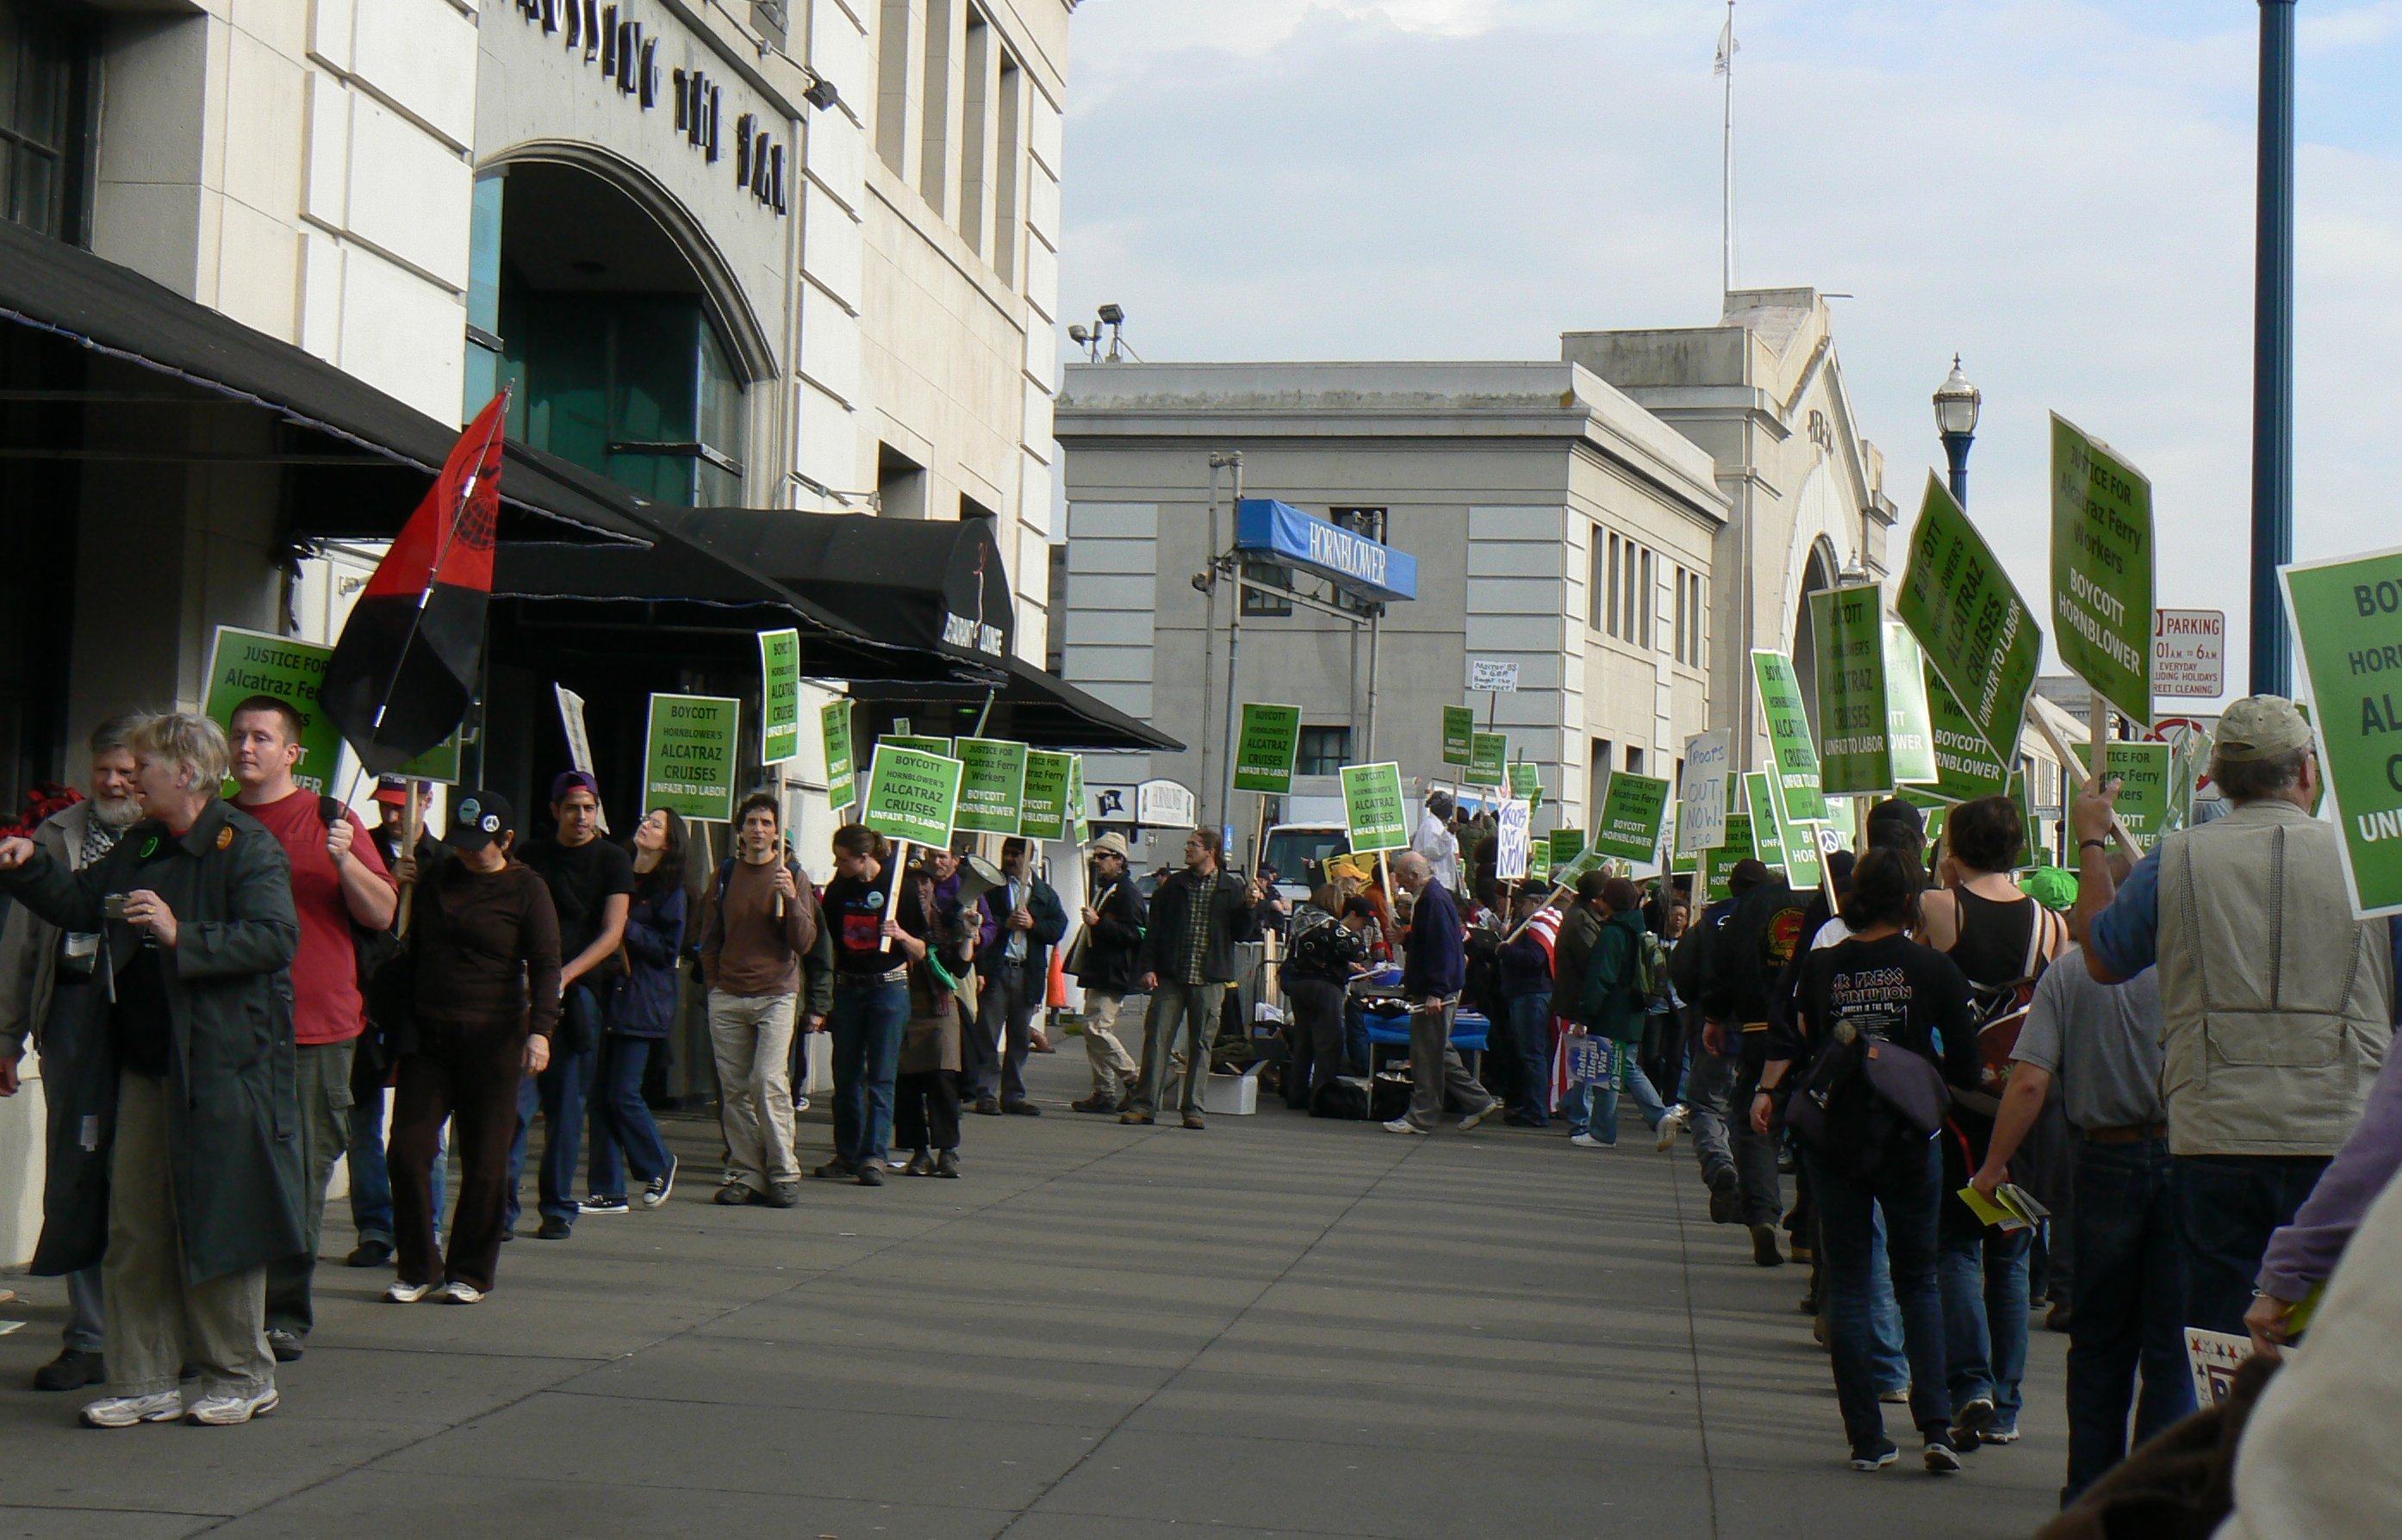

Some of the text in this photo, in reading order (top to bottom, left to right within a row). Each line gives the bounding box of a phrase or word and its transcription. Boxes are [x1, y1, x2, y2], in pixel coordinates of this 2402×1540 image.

[2071, 444, 2131, 507] JUSTICE FOR
[2061, 473, 2142, 555] Alcatraz Ferry
[1310, 522, 1386, 586] HORNBLOWER
[2074, 518, 2123, 575] Workers
[1914, 516, 1943, 604] BOYCOTT
[2069, 566, 2125, 628] BOYCOTT
[2354, 579, 2402, 618] BO
[1945, 556, 1985, 669] ALCATRAZ
[1998, 598, 2021, 651] LABOR
[2167, 618, 2219, 636] PARKING
[1966, 593, 2003, 687] CRUISES
[2058, 591, 2141, 677] HORNBLOWER
[244, 646, 301, 669] JUSTICE
[1991, 648, 2006, 671] TO
[2159, 662, 2197, 671] EVERYDAY
[2349, 644, 2402, 675] HOR
[225, 668, 293, 696] Alcatraz
[2181, 673, 2218, 681] HOLIDAYS
[2175, 685, 2212, 693] CLEANING
[1978, 670, 2001, 728] UNFAIR
[671, 706, 718, 720] BOYCOTT
[1255, 711, 1286, 721] BOYCOTT
[663, 727, 723, 740] HORNBLOWER'S
[1935, 729, 1988, 755] BOYCOTT
[662, 744, 722, 761] ALCATRAZ
[969, 745, 1013, 756] JUSTICE FOR
[1248, 738, 1288, 751] ALCATRAZ
[1686, 740, 1724, 766] TROOPS
[1825, 738, 1847, 757] UNFAIR
[1858, 734, 1884, 754] LABOR
[895, 755, 942, 773] BOYCOTT
[963, 756, 1018, 771] Alcatraz Ferry
[1047, 758, 1060, 767] FOR
[1248, 754, 1283, 766] CRUISES
[2131, 752, 2150, 763] FOR
[664, 765, 716, 781] CRUISES
[887, 770, 944, 788] HORNBLOWER'S
[972, 771, 1005, 783] Workers
[1044, 771, 1064, 783] Ferry
[1355, 771, 1385, 782] BOYCOTT
[2129, 769, 2159, 786] Ferry
[650, 782, 726, 797] UNFAIR TO LABOR
[882, 782, 943, 803] ALCATRAZ
[967, 789, 1006, 802] BOYCOTT
[1027, 783, 1052, 792] orkers
[1688, 779, 1720, 803] OUT
[885, 798, 937, 817] CRUISES
[1355, 798, 1394, 810] ALCATRAZ
[1641, 794, 1659, 806] Ferry
[956, 802, 1015, 817] HORNBLOWER
[1360, 812, 1393, 824] CRUISES
[870, 810, 946, 831] UNFAIR TO LABOR
[1613, 819, 1646, 832] BOYCOTT
[1602, 829, 1652, 847] HORNBLOWER
[1855, 967, 1904, 988] PRESS
[1598, 1050, 1608, 1074] War
